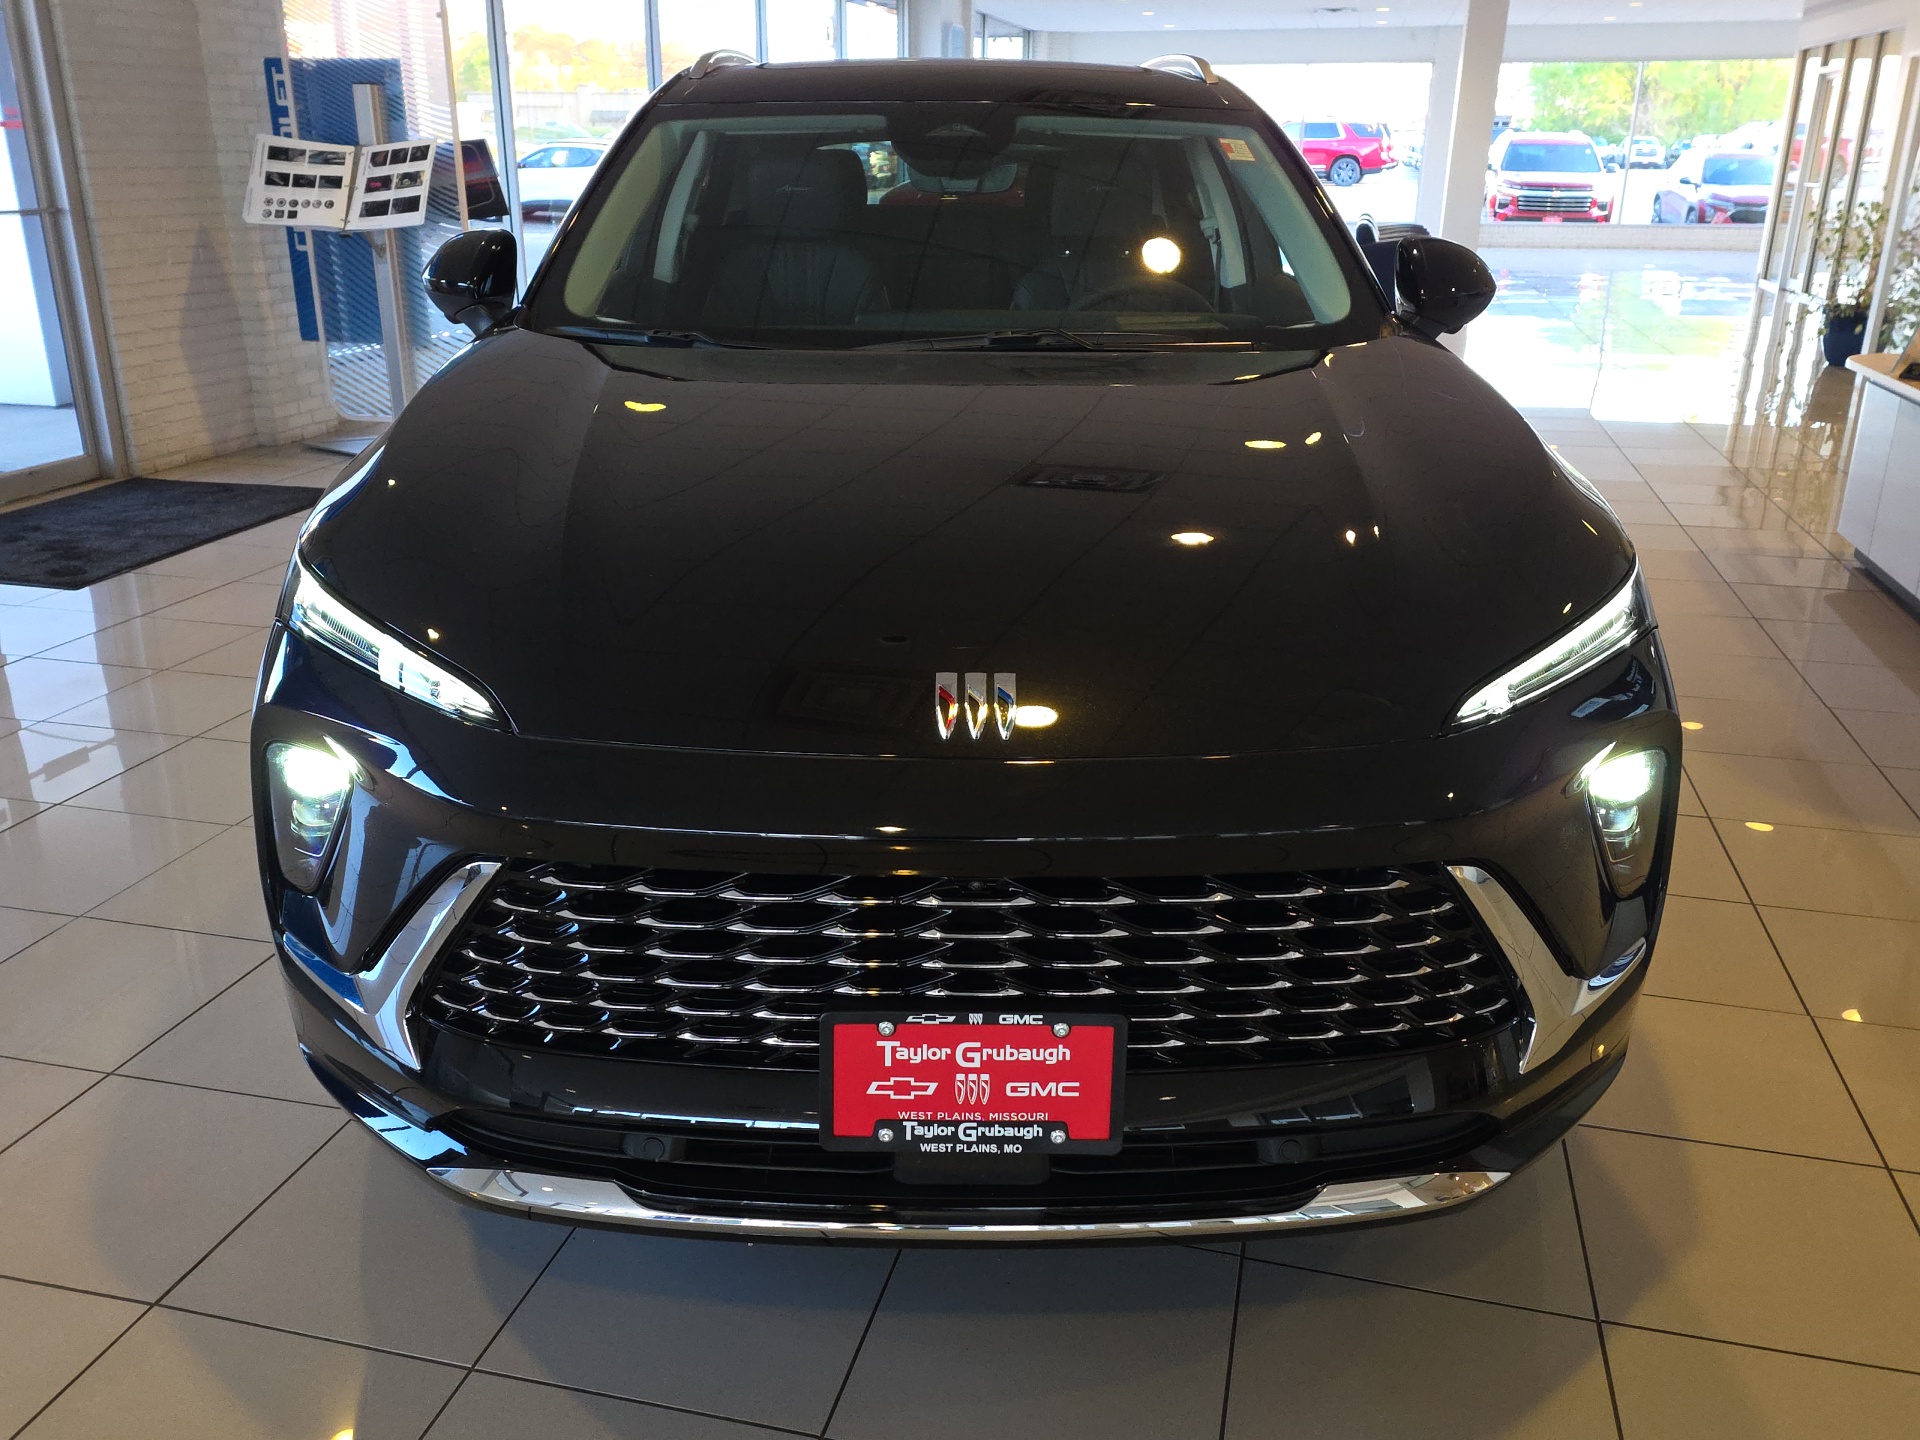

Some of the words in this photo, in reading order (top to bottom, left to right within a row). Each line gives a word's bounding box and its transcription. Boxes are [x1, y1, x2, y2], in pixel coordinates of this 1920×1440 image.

[998, 1014, 1043, 1025] GMC
[876, 1040, 951, 1067] Taylor
[955, 1041, 1071, 1068] Grubaugh
[1005, 1081, 1080, 1097] GMC
[897, 1111, 933, 1120] WEST
[937, 1111, 985, 1122] PLAINS,
[989, 1112, 1049, 1121] MISSOURI
[902, 1121, 956, 1141] Taylor
[957, 1122, 1043, 1142] Grubaugh
[919, 1142, 954, 1153] WEST
[955, 1143, 1001, 1155] PLAINS,
[1003, 1143, 1023, 1154] MO
